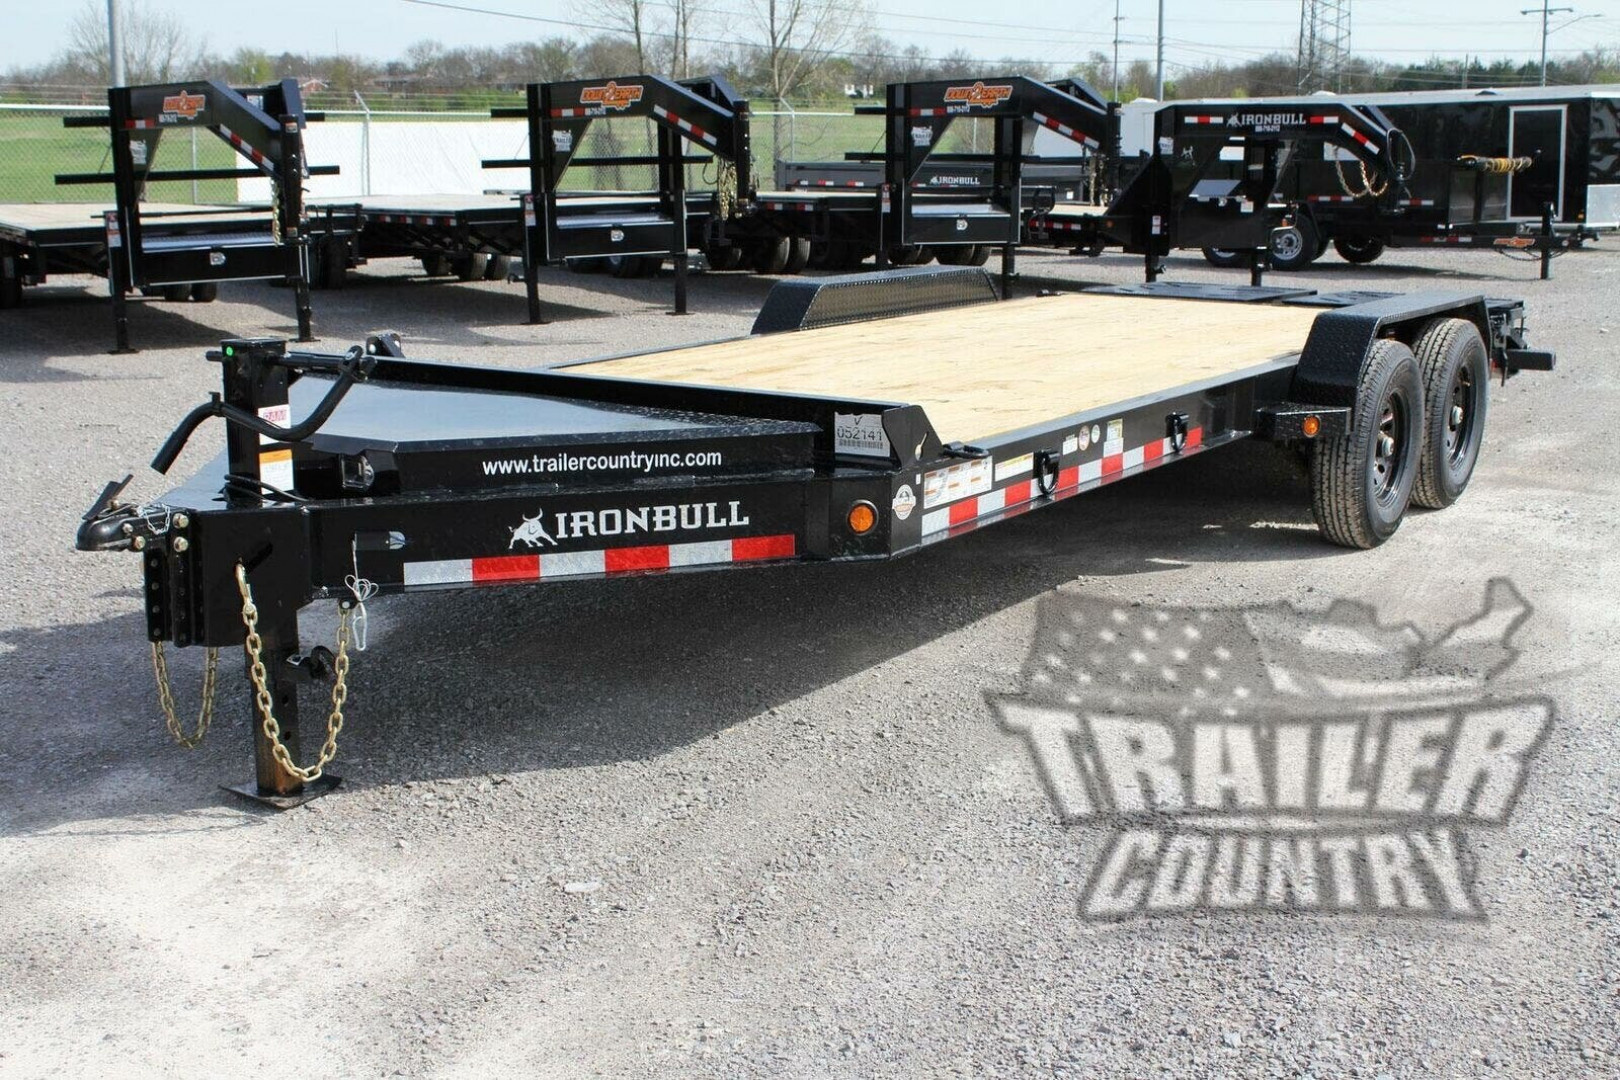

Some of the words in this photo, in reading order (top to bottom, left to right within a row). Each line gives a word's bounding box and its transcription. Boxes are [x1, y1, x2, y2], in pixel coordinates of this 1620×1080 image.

[983, 87, 1010, 98] EARTH
[1241, 114, 1306, 125] IRONBULL
[939, 176, 980, 185] IRONBULL
[837, 426, 883, 441] 052141
[482, 450, 722, 476] www.trailercountryinc.com
[556, 501, 750, 539] IRONBULL
